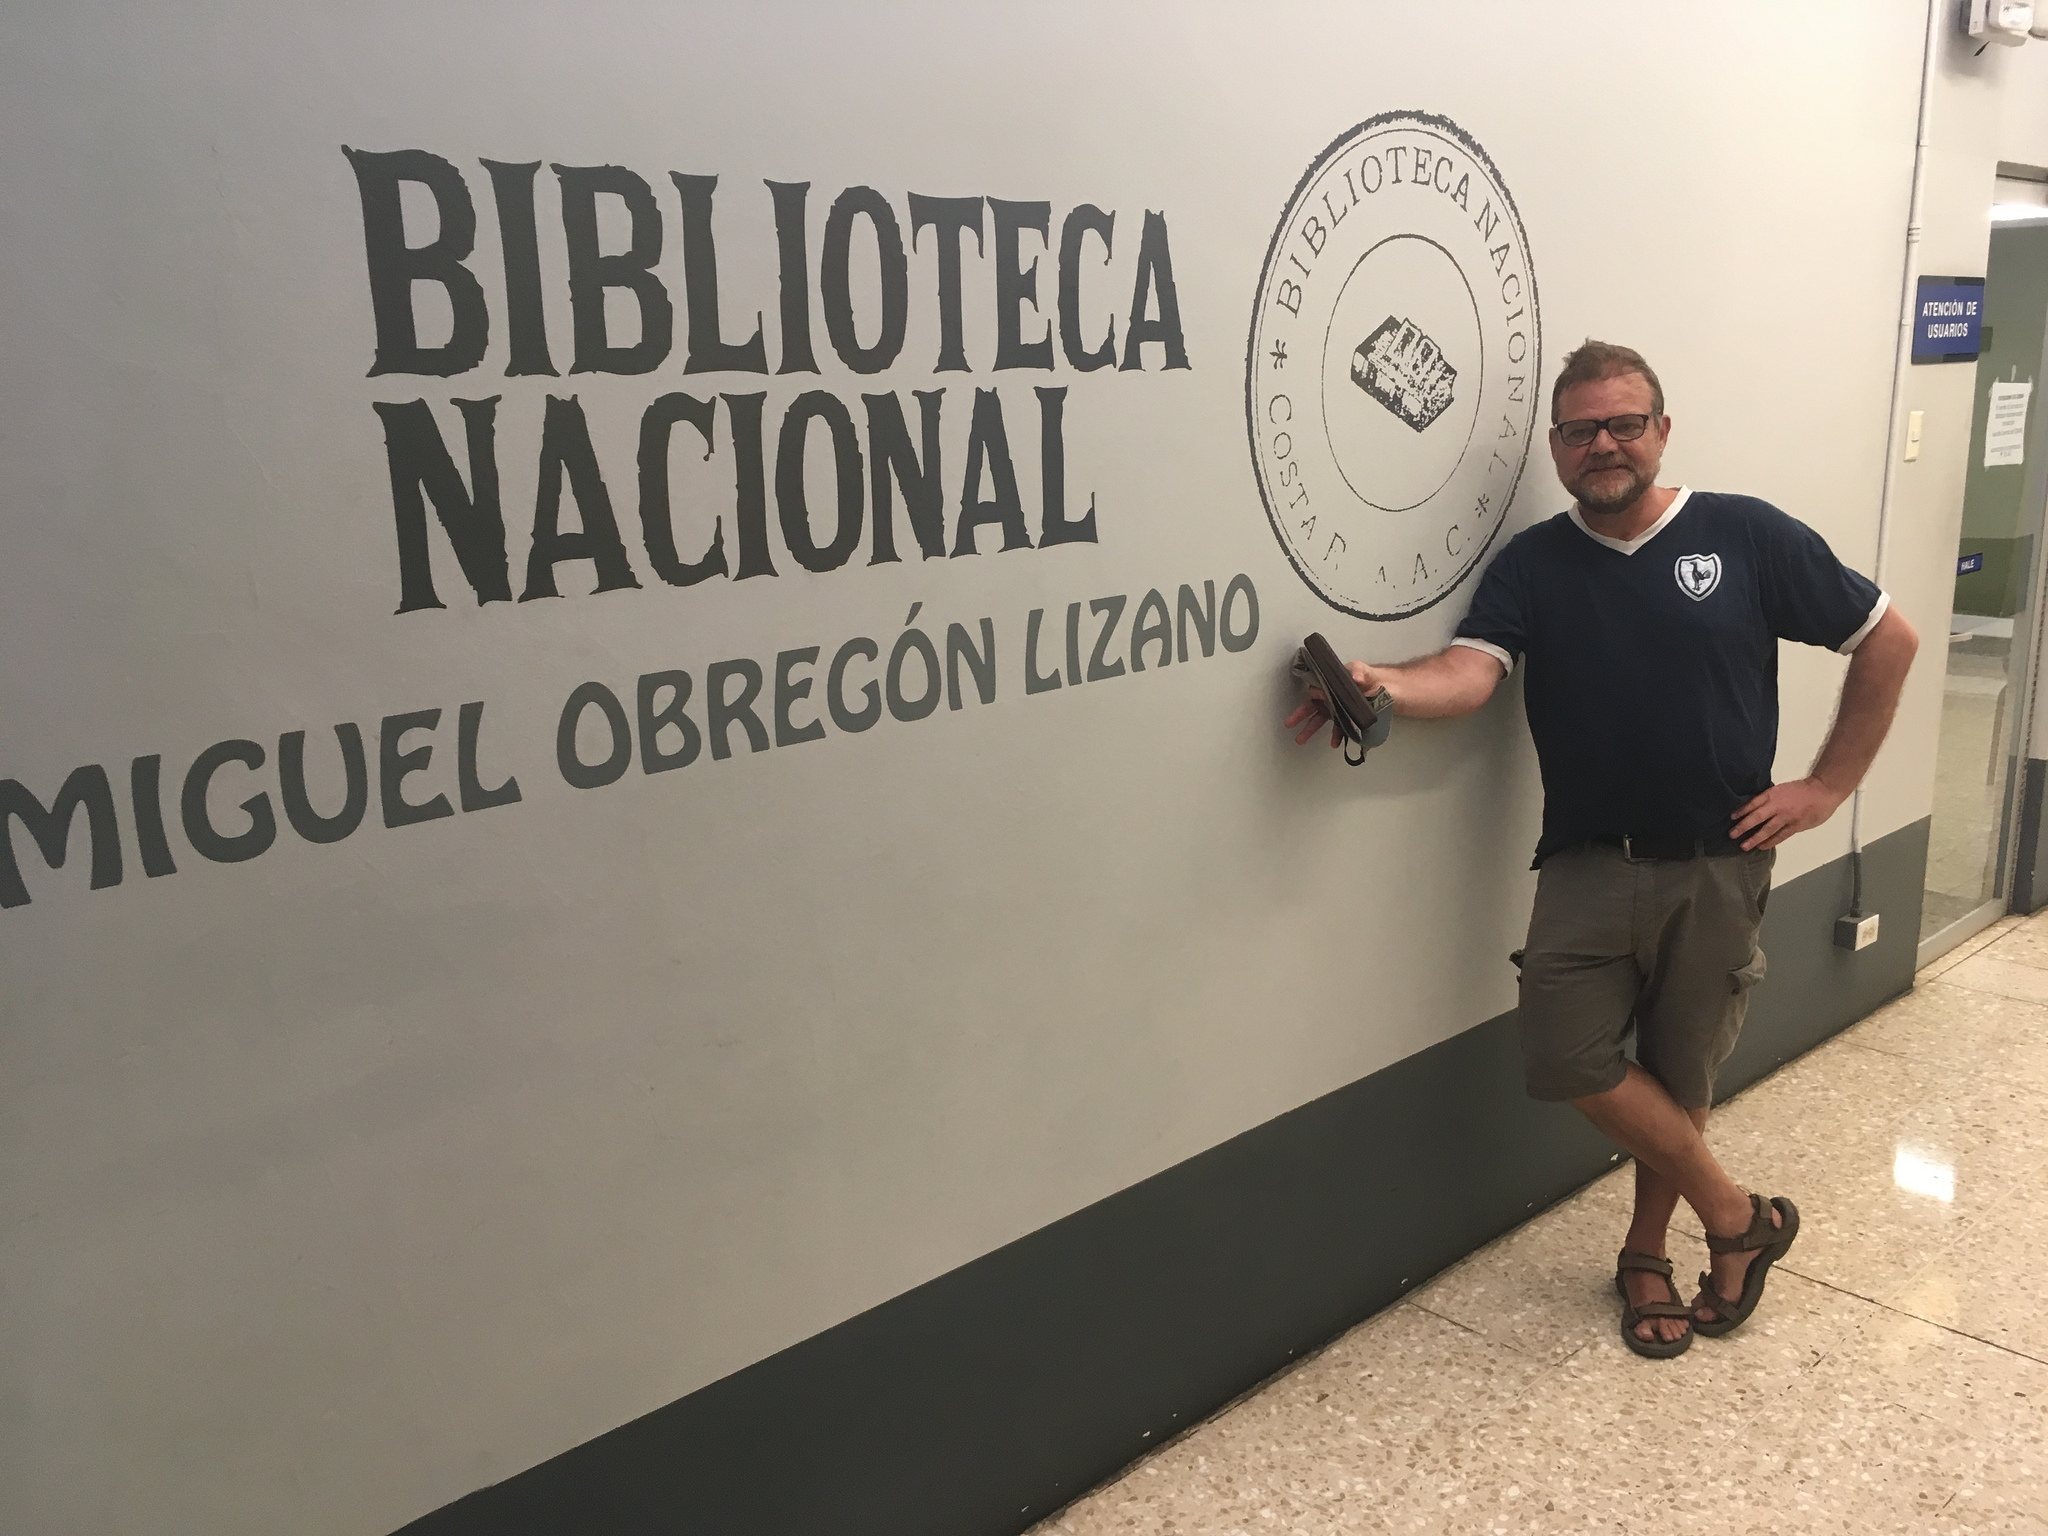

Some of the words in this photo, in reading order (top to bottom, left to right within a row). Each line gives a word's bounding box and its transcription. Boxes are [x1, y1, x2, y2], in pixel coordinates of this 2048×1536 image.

[341, 144, 1193, 378] BIBLIOTECA
[1276, 146, 1470, 318] BIBLIOTECA
[1474, 198, 1526, 474] NACIONAL
[1922, 299, 1964, 317] ATENCIÓN
[1966, 301, 1978, 316] DE
[1927, 323, 1968, 339] USUARIOS
[372, 386, 1099, 616] NACIONAL
[1268, 393, 1317, 540] COSTA
[0, 701, 522, 910] MIGUEL
[557, 602, 996, 790] OBREGÓN
[1025, 574, 1260, 696] LIZANO
